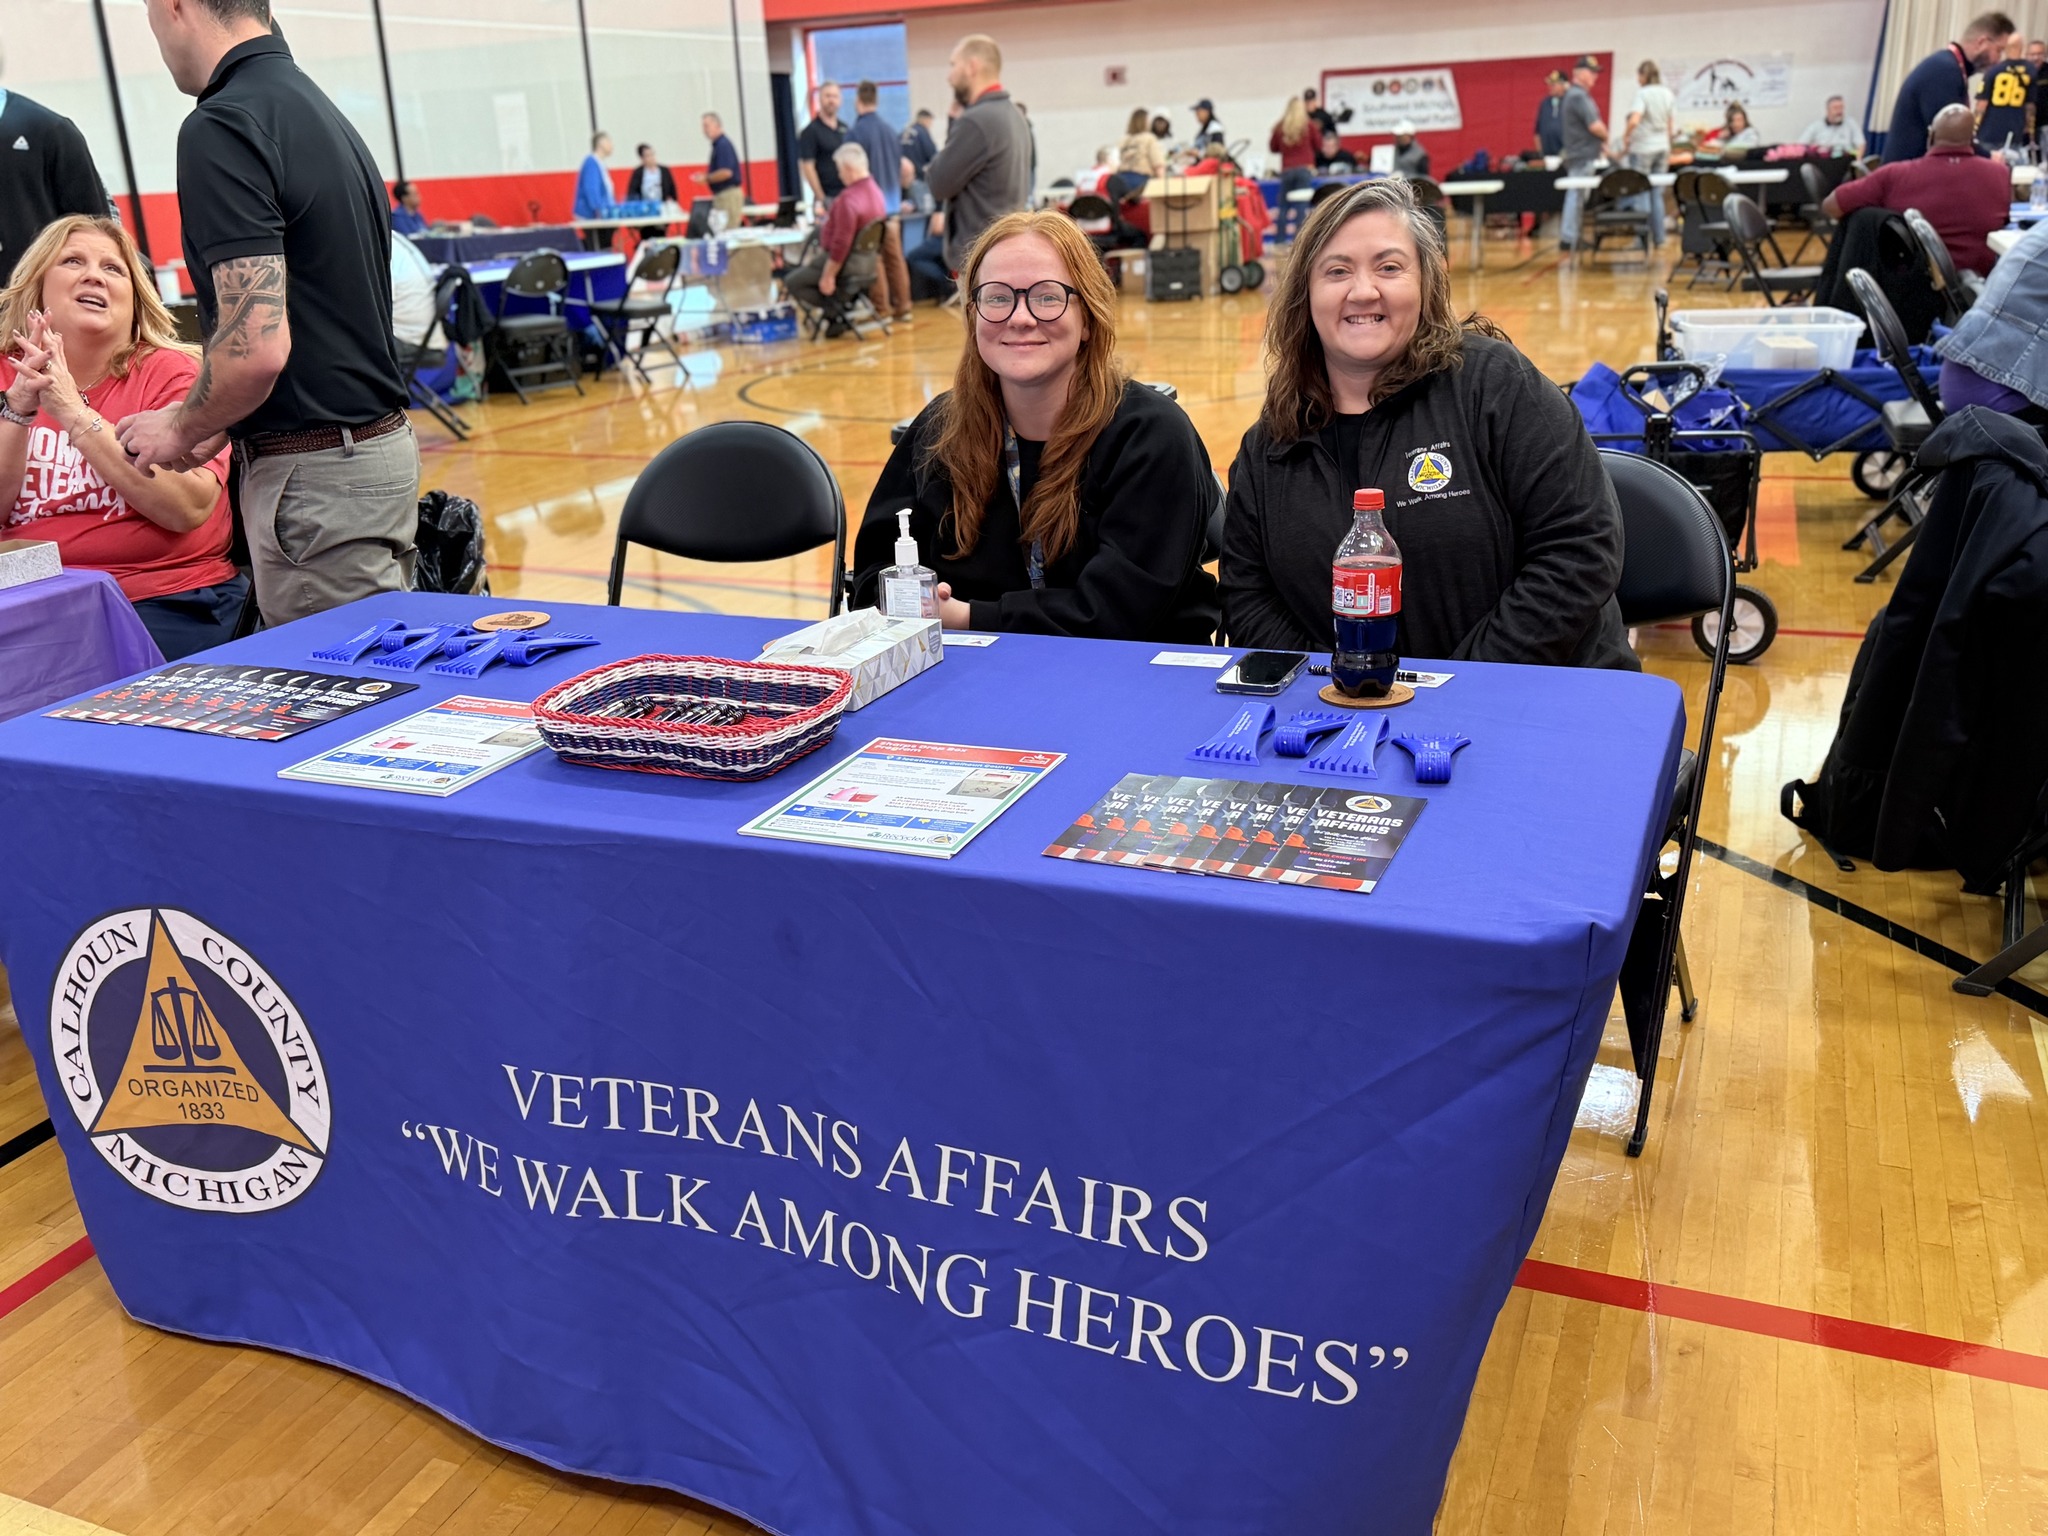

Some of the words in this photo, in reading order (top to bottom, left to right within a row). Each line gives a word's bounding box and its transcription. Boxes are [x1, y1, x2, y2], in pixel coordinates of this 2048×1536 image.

[1992, 72, 2031, 107] 86
[1430, 441, 1451, 451] Affairs
[1415, 480, 1446, 491] MICHIGAN
[1408, 496, 1423, 506] Walk
[1424, 493, 1447, 501] Among
[1448, 489, 1471, 497] Heroes
[874, 744, 922, 753] Program
[879, 741, 918, 750] Sharps
[1316, 809, 1403, 827] VETERANS
[1318, 819, 1390, 835] AFFAIRS
[61, 921, 138, 1102] CALHOUN
[202, 937, 321, 1109] COUNTY
[128, 1078, 260, 1103] ORGANIZED
[178, 1102, 226, 1121] 1833
[106, 1136, 310, 1205] MICHIGAN
[501, 1064, 863, 1179] VETERANS
[875, 1137, 1209, 1263] AFFAIRS
[401, 1120, 503, 1198] “WE
[513, 1155, 718, 1233] WALK
[731, 1190, 991, 1318] AMONG
[1010, 1268, 1410, 1405] HEROES”
